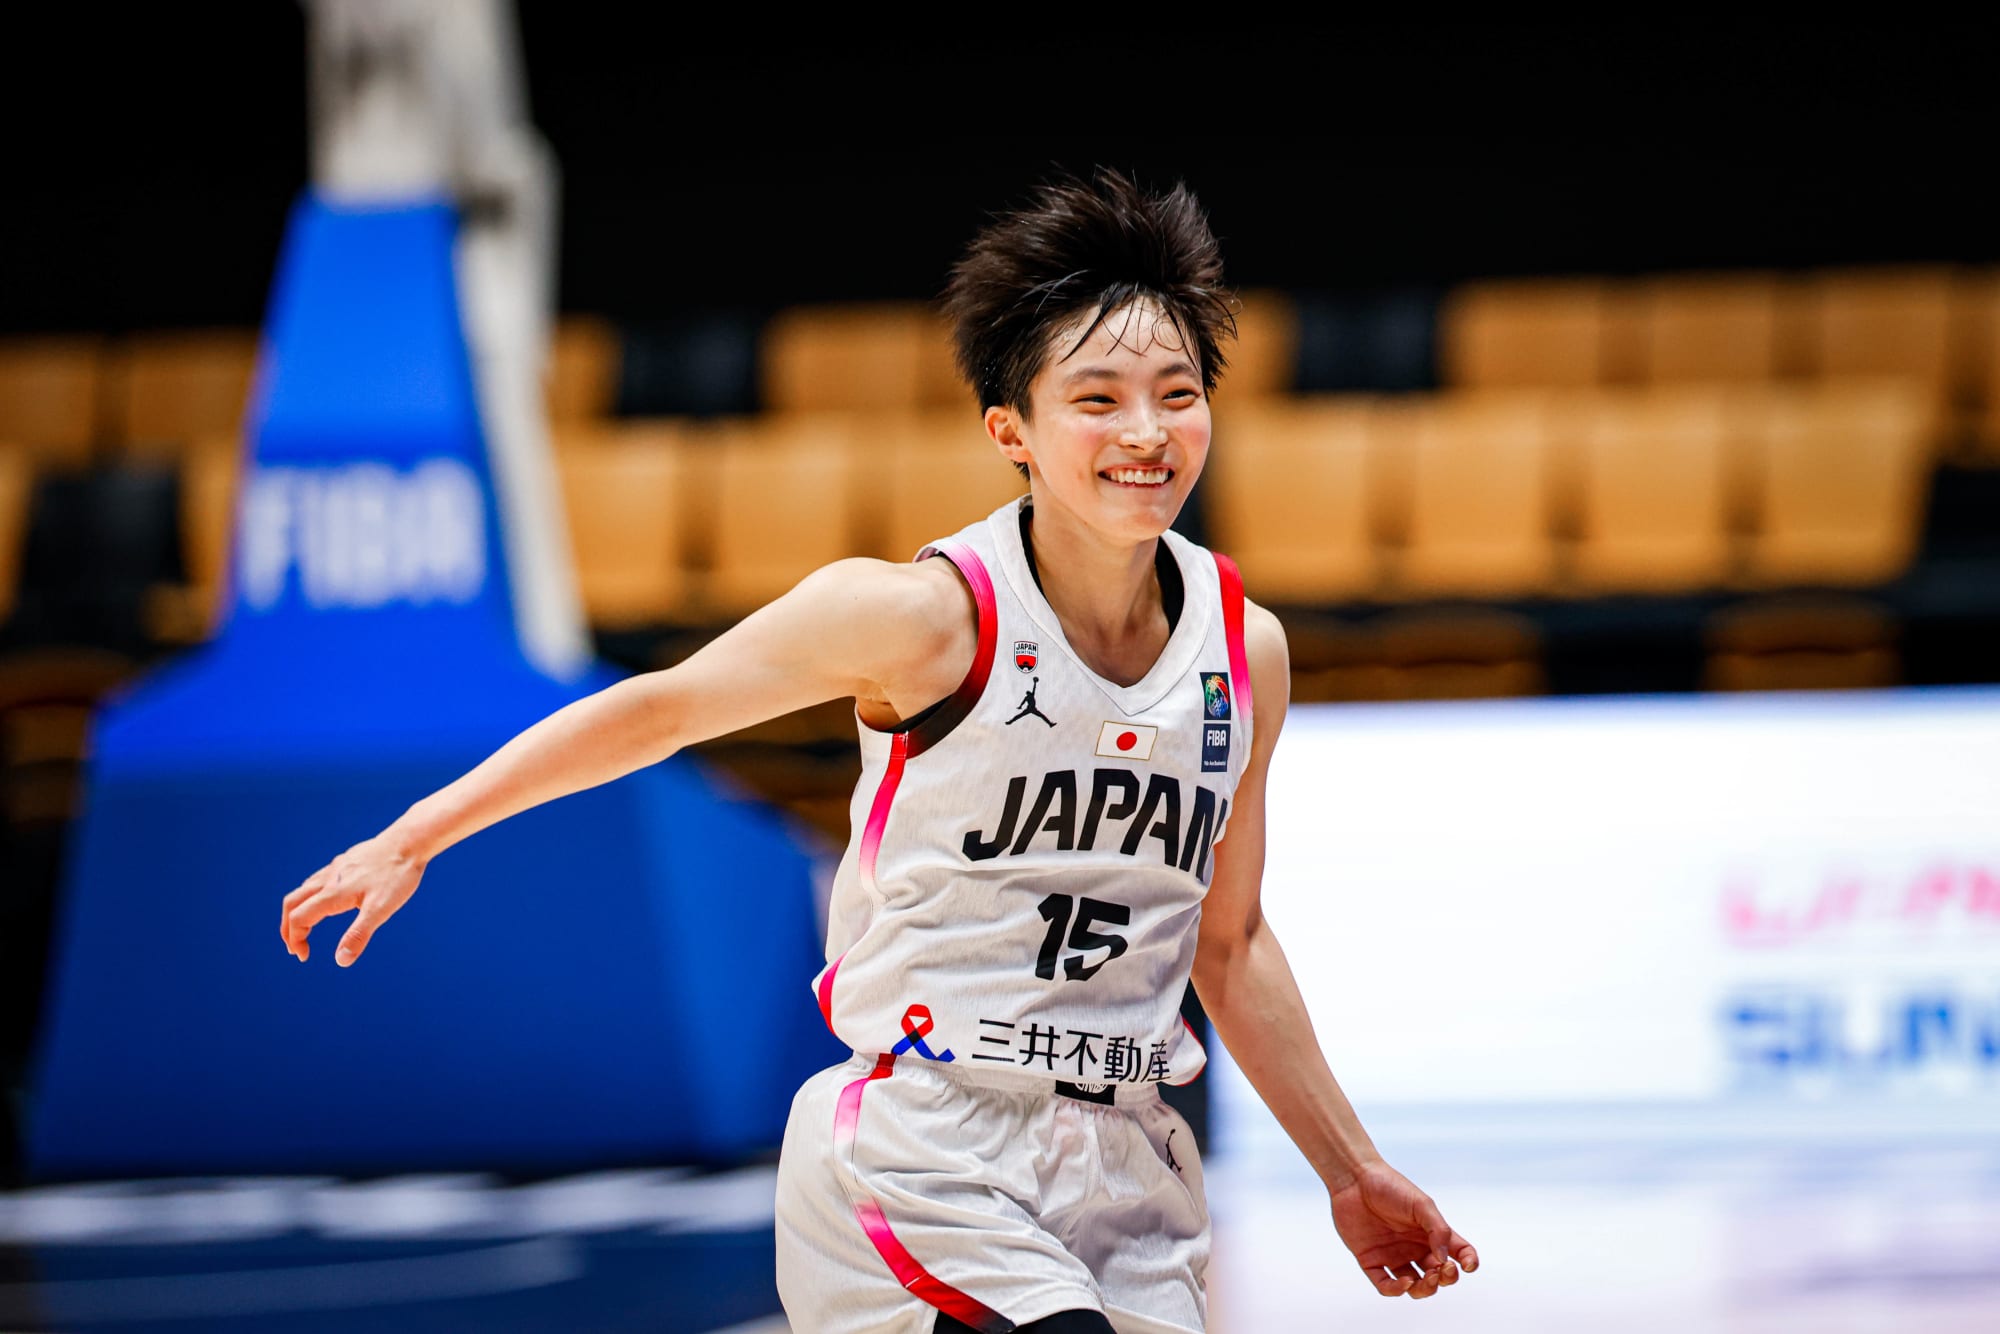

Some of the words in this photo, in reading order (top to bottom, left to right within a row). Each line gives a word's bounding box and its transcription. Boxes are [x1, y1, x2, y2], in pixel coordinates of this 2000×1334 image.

[245, 464, 485, 607] FIBA
[1016, 643, 1036, 651] JAPAN
[1207, 730, 1226, 746] FIBA
[962, 769, 1228, 881] JAPAN
[1035, 893, 1130, 981] 15
[972, 1018, 1171, 1083] 三井不動産
